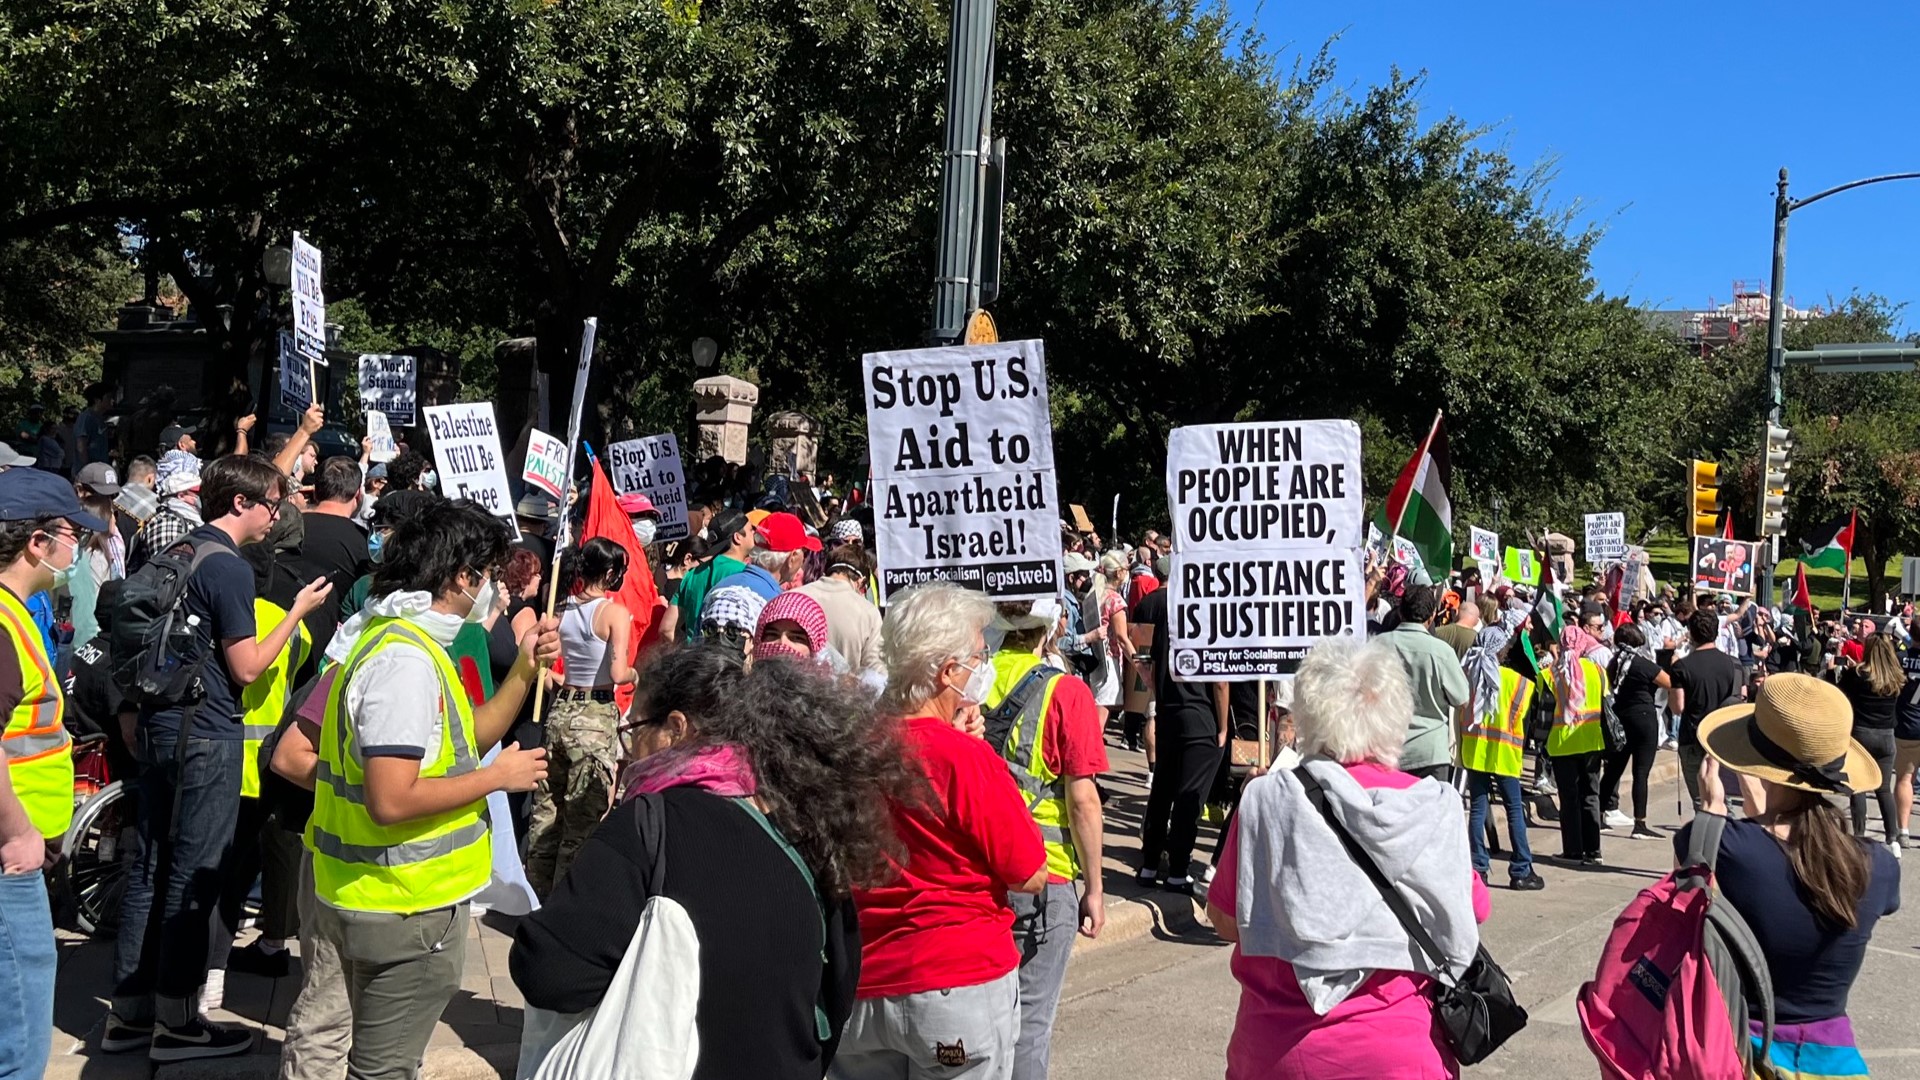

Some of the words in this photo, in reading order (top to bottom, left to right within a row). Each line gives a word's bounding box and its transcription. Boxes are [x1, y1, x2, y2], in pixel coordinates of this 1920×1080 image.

[297, 268, 310, 297] Will
[310, 277, 320, 302] Be
[300, 299, 318, 333] Free
[380, 358, 413, 373] World
[288, 375, 306, 398] Free
[368, 375, 407, 389] Stands
[871, 365, 961, 417] Stop
[970, 356, 1039, 401] U.S.
[362, 398, 413, 411] Palestine
[429, 409, 493, 440] Palestine
[445, 444, 478, 474] Will
[477, 444, 495, 471] Be
[545, 439, 566, 466] FRE
[612, 449, 646, 468] Stop
[648, 440, 676, 460] U.S.
[894, 422, 974, 471] Aid
[987, 428, 1031, 465] to
[1216, 426, 1302, 464] WHEN
[526, 454, 566, 487] PALEST
[624, 469, 654, 493] Aid
[658, 470, 676, 486] to
[1178, 466, 1280, 504] PEOPLE
[1288, 463, 1345, 500] ARE
[457, 482, 499, 510] Free
[649, 487, 682, 507] theid
[884, 472, 1046, 528] Apartheid
[655, 506, 677, 524] ael!
[1188, 503, 1336, 545] OCCUPIED,
[1587, 521, 1608, 530] PEOPLE
[1609, 520, 1621, 528] ARE
[922, 518, 1026, 560] Israel!
[1587, 546, 1594, 554] IS
[1589, 538, 1621, 547] RESISTANCE
[886, 570, 914, 585] Party
[915, 568, 931, 582] for
[933, 567, 980, 581] Socialism
[986, 563, 1053, 591] @pslweb
[1182, 559, 1346, 599] RESISTANCE
[1177, 603, 1201, 640] IS
[1207, 600, 1354, 645] JUSTIFIED!
[1178, 655, 1198, 670] PSL
[1203, 650, 1227, 662] Party
[1229, 649, 1242, 660] for
[1243, 648, 1287, 660] Socialism
[1288, 648, 1306, 659] and
[1203, 661, 1278, 674] PSLweb.org
